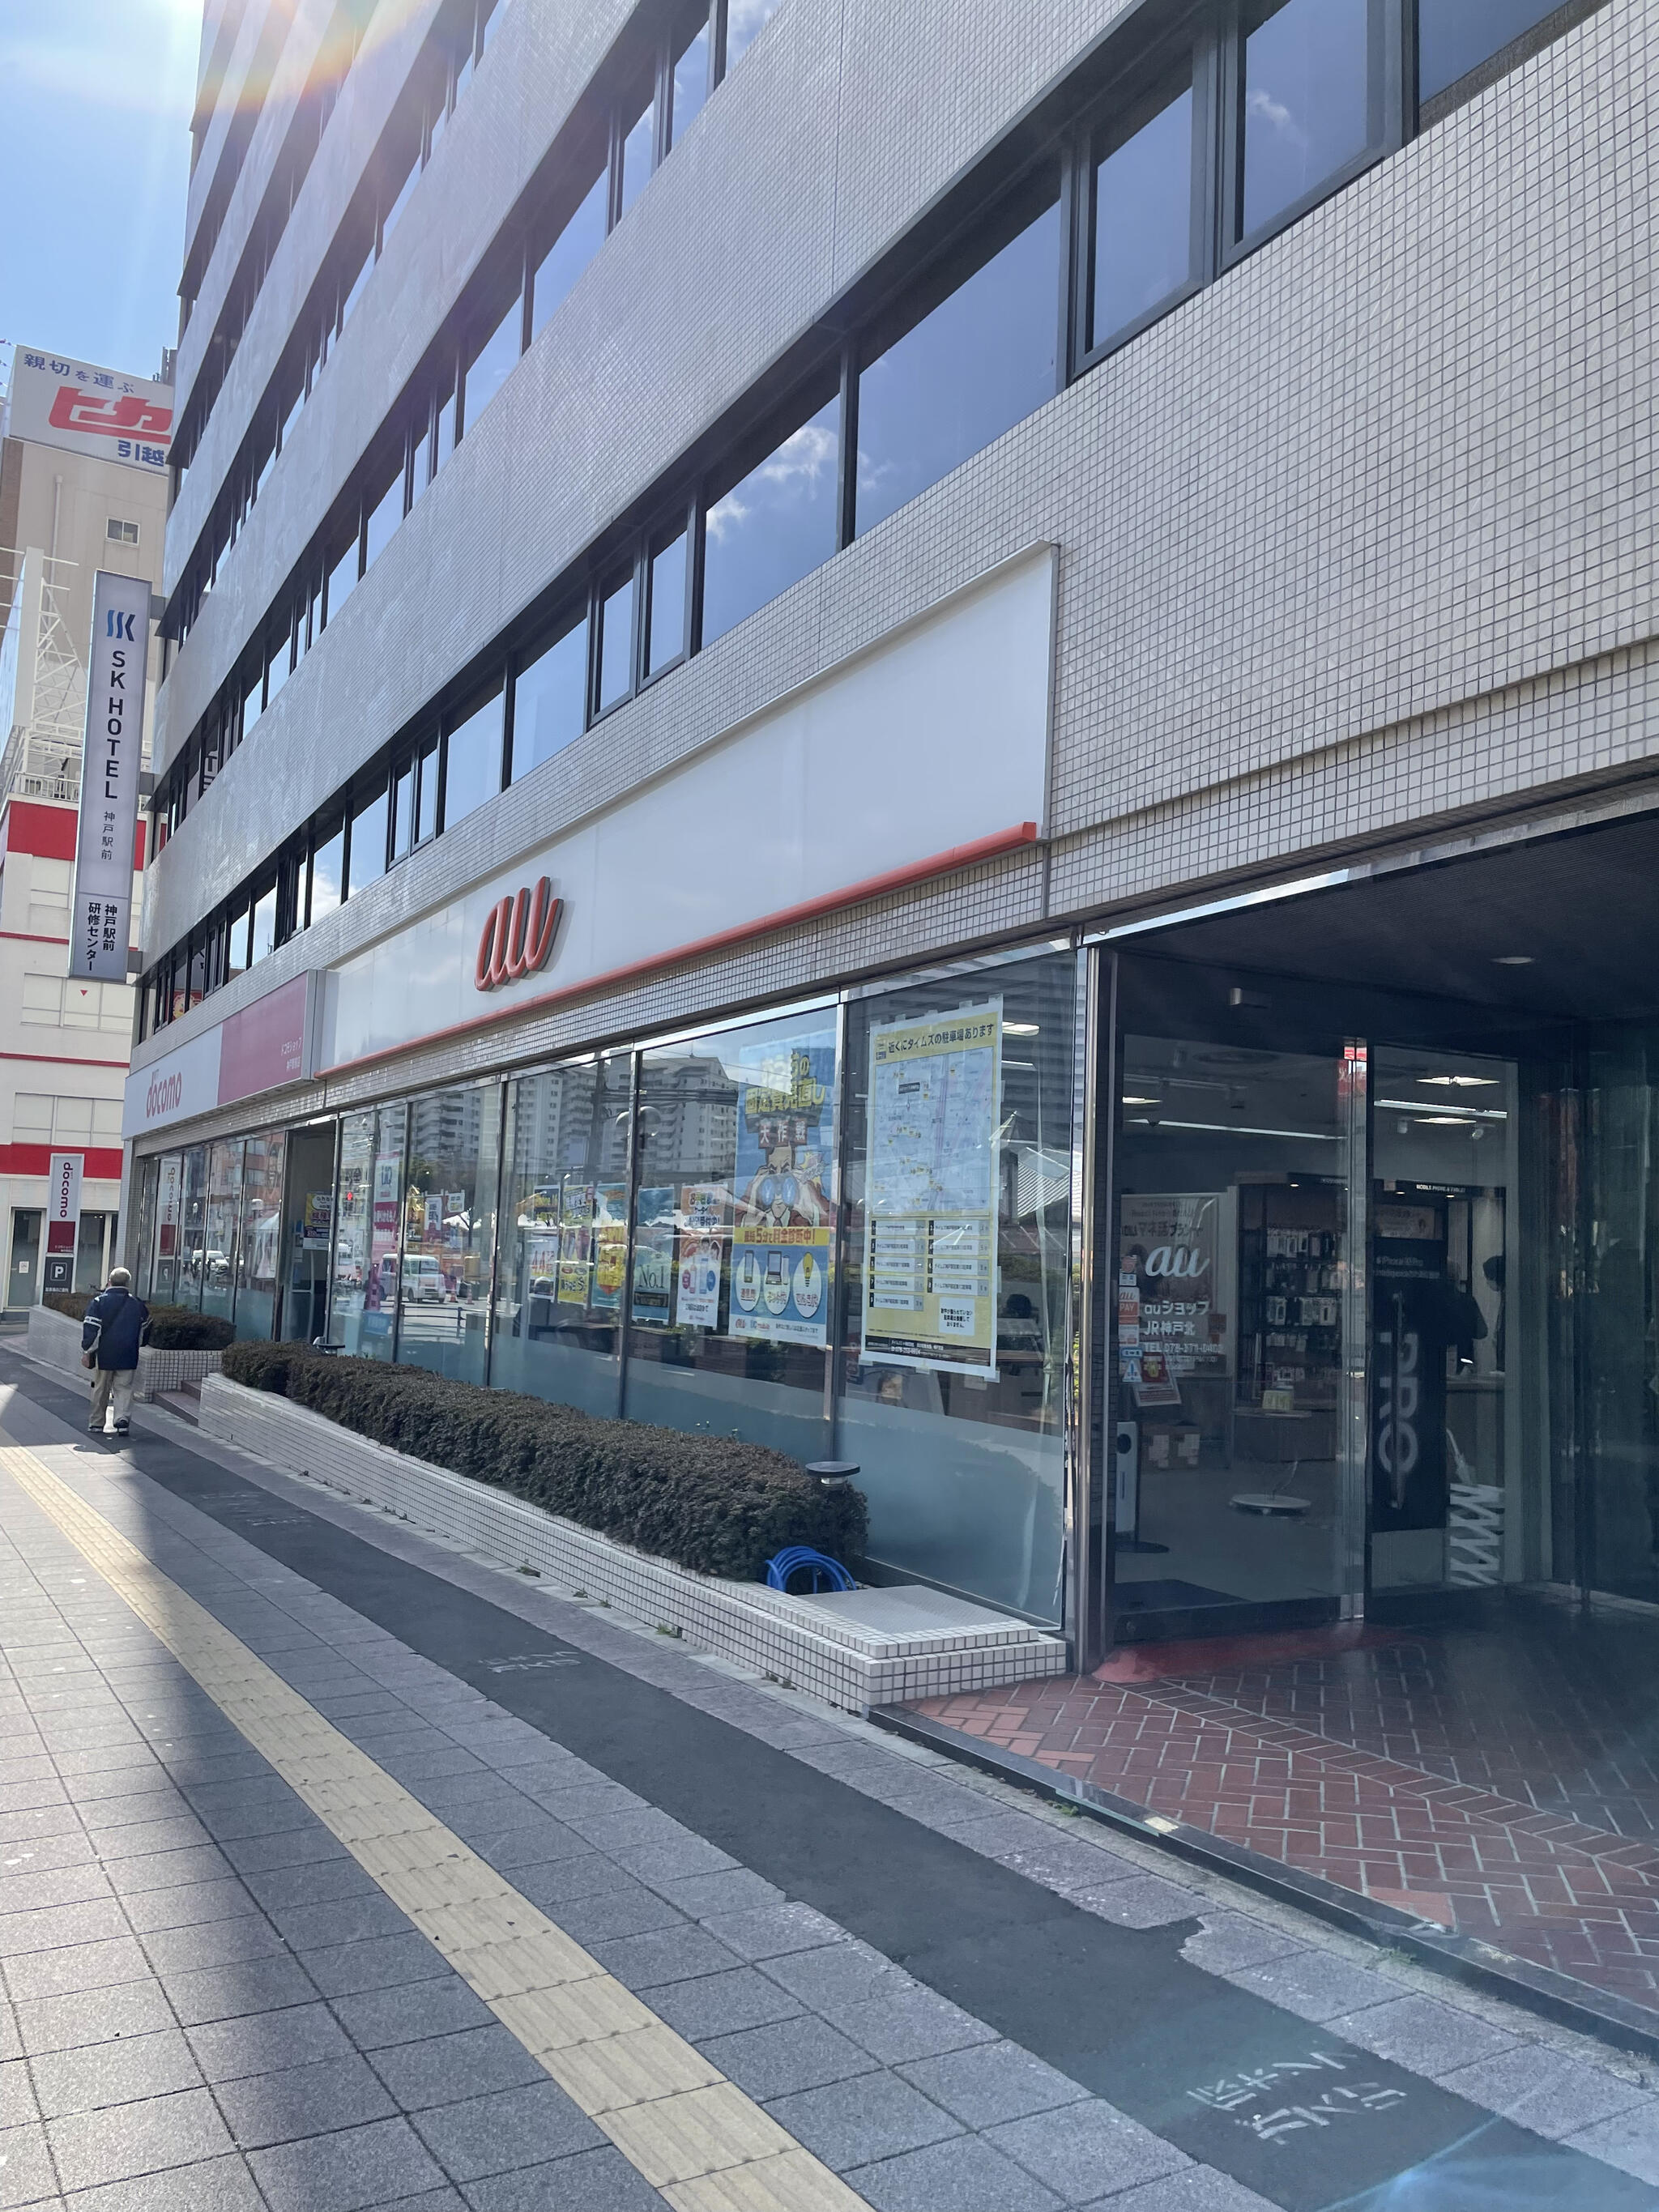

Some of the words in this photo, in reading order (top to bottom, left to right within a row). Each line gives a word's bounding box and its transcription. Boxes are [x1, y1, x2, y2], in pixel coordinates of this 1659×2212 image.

[24, 353, 134, 394] 親切を運ぶ
[117, 440, 164, 467] 引越
[110, 650, 126, 690] SK
[104, 697, 123, 799] HOTEL
[100, 811, 116, 860] 神戸駅前
[85, 901, 101, 972] 研修センター
[103, 903, 118, 952] 神戸駅前
[888, 1024, 994, 1054] 近くにタイムズの駐車場あります
[147, 1071, 182, 1119] docomo
[60, 1161, 74, 1218] docomo
[54, 1265, 64, 1278] P
[638, 1264, 665, 1289] No.1
[1145, 1244, 1210, 1278] au
[1120, 1303, 1135, 1312] PAY
[1145, 1299, 1210, 1315] auショップ
[1144, 1320, 1196, 1336] JR神戸北
